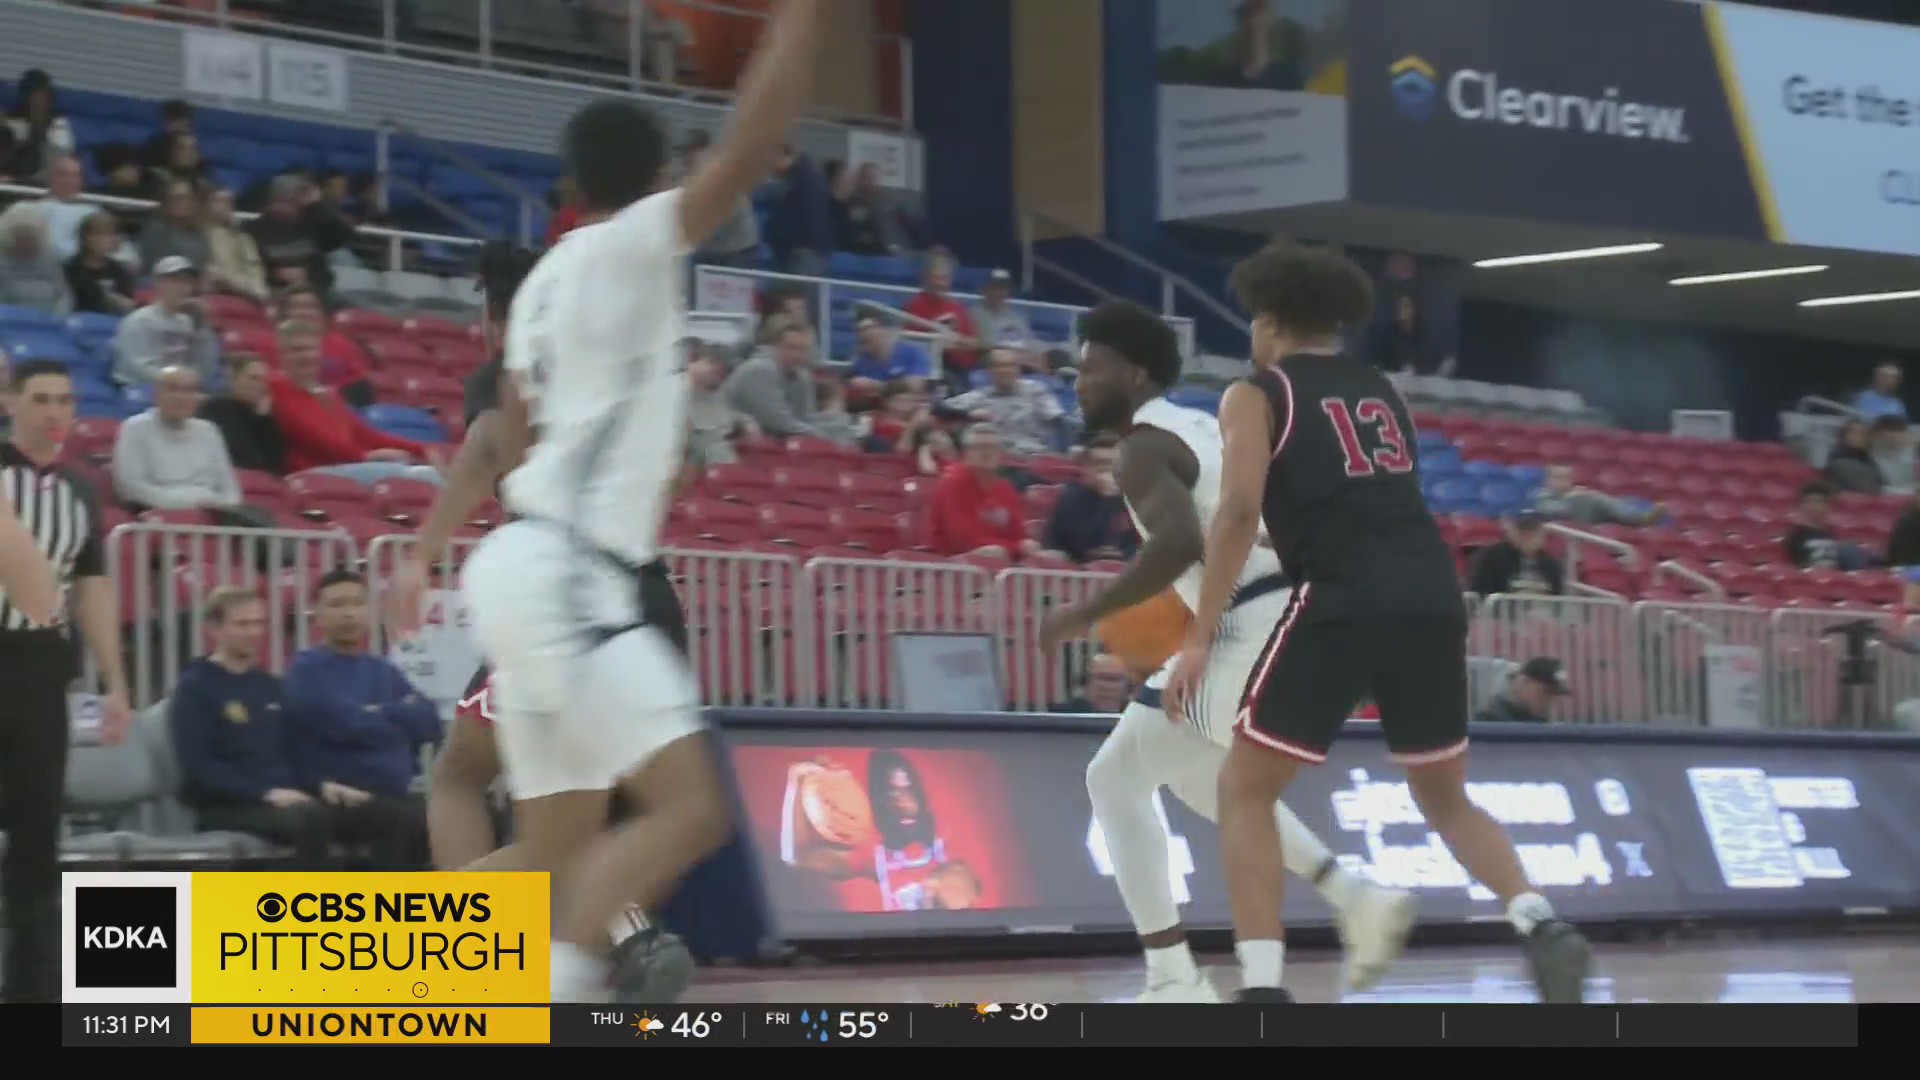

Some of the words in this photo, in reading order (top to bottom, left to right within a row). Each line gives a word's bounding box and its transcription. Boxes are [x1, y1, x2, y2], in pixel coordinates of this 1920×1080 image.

[1446, 68, 1693, 144] Clearview.
[1779, 74, 1848, 118] Get
[1320, 397, 1413, 477] 13
